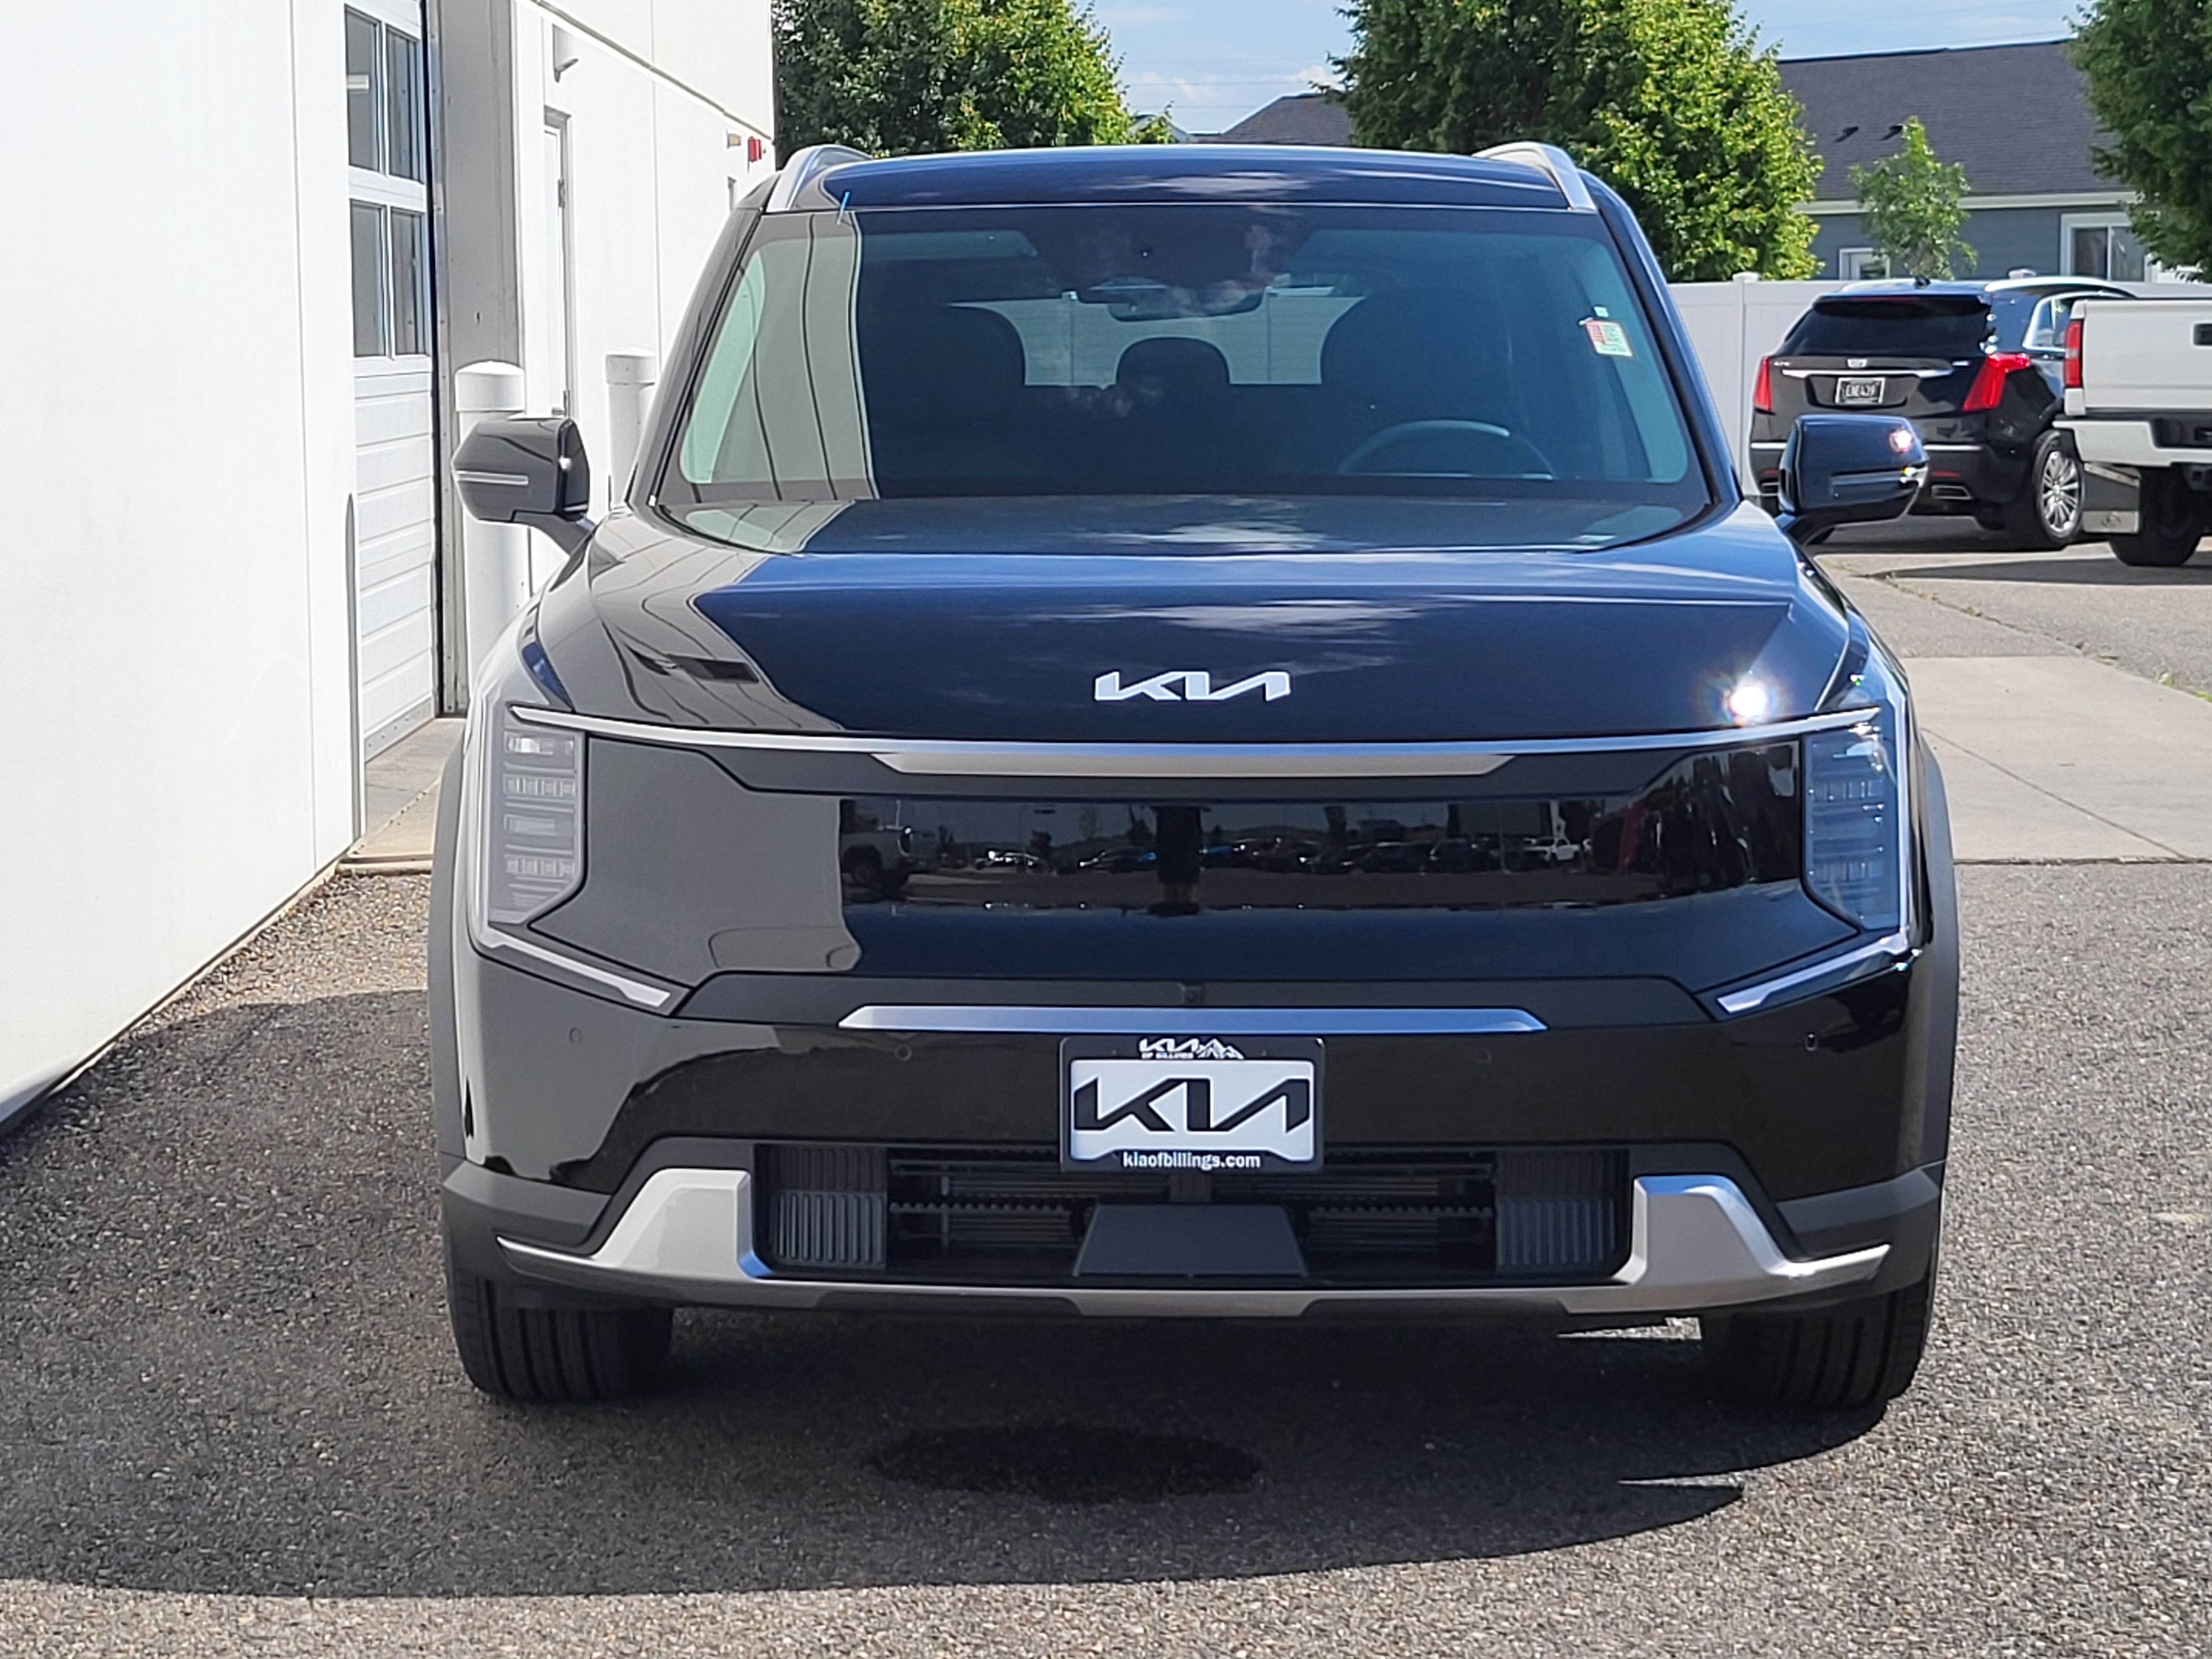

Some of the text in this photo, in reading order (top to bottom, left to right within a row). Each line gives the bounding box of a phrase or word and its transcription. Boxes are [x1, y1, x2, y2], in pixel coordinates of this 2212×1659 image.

[1095, 671, 1291, 701] KIA
[1139, 1038, 1199, 1052] KIA
[1074, 1077, 1310, 1132] KIA
[1123, 1151, 1260, 1171] kiaofbillings.com
